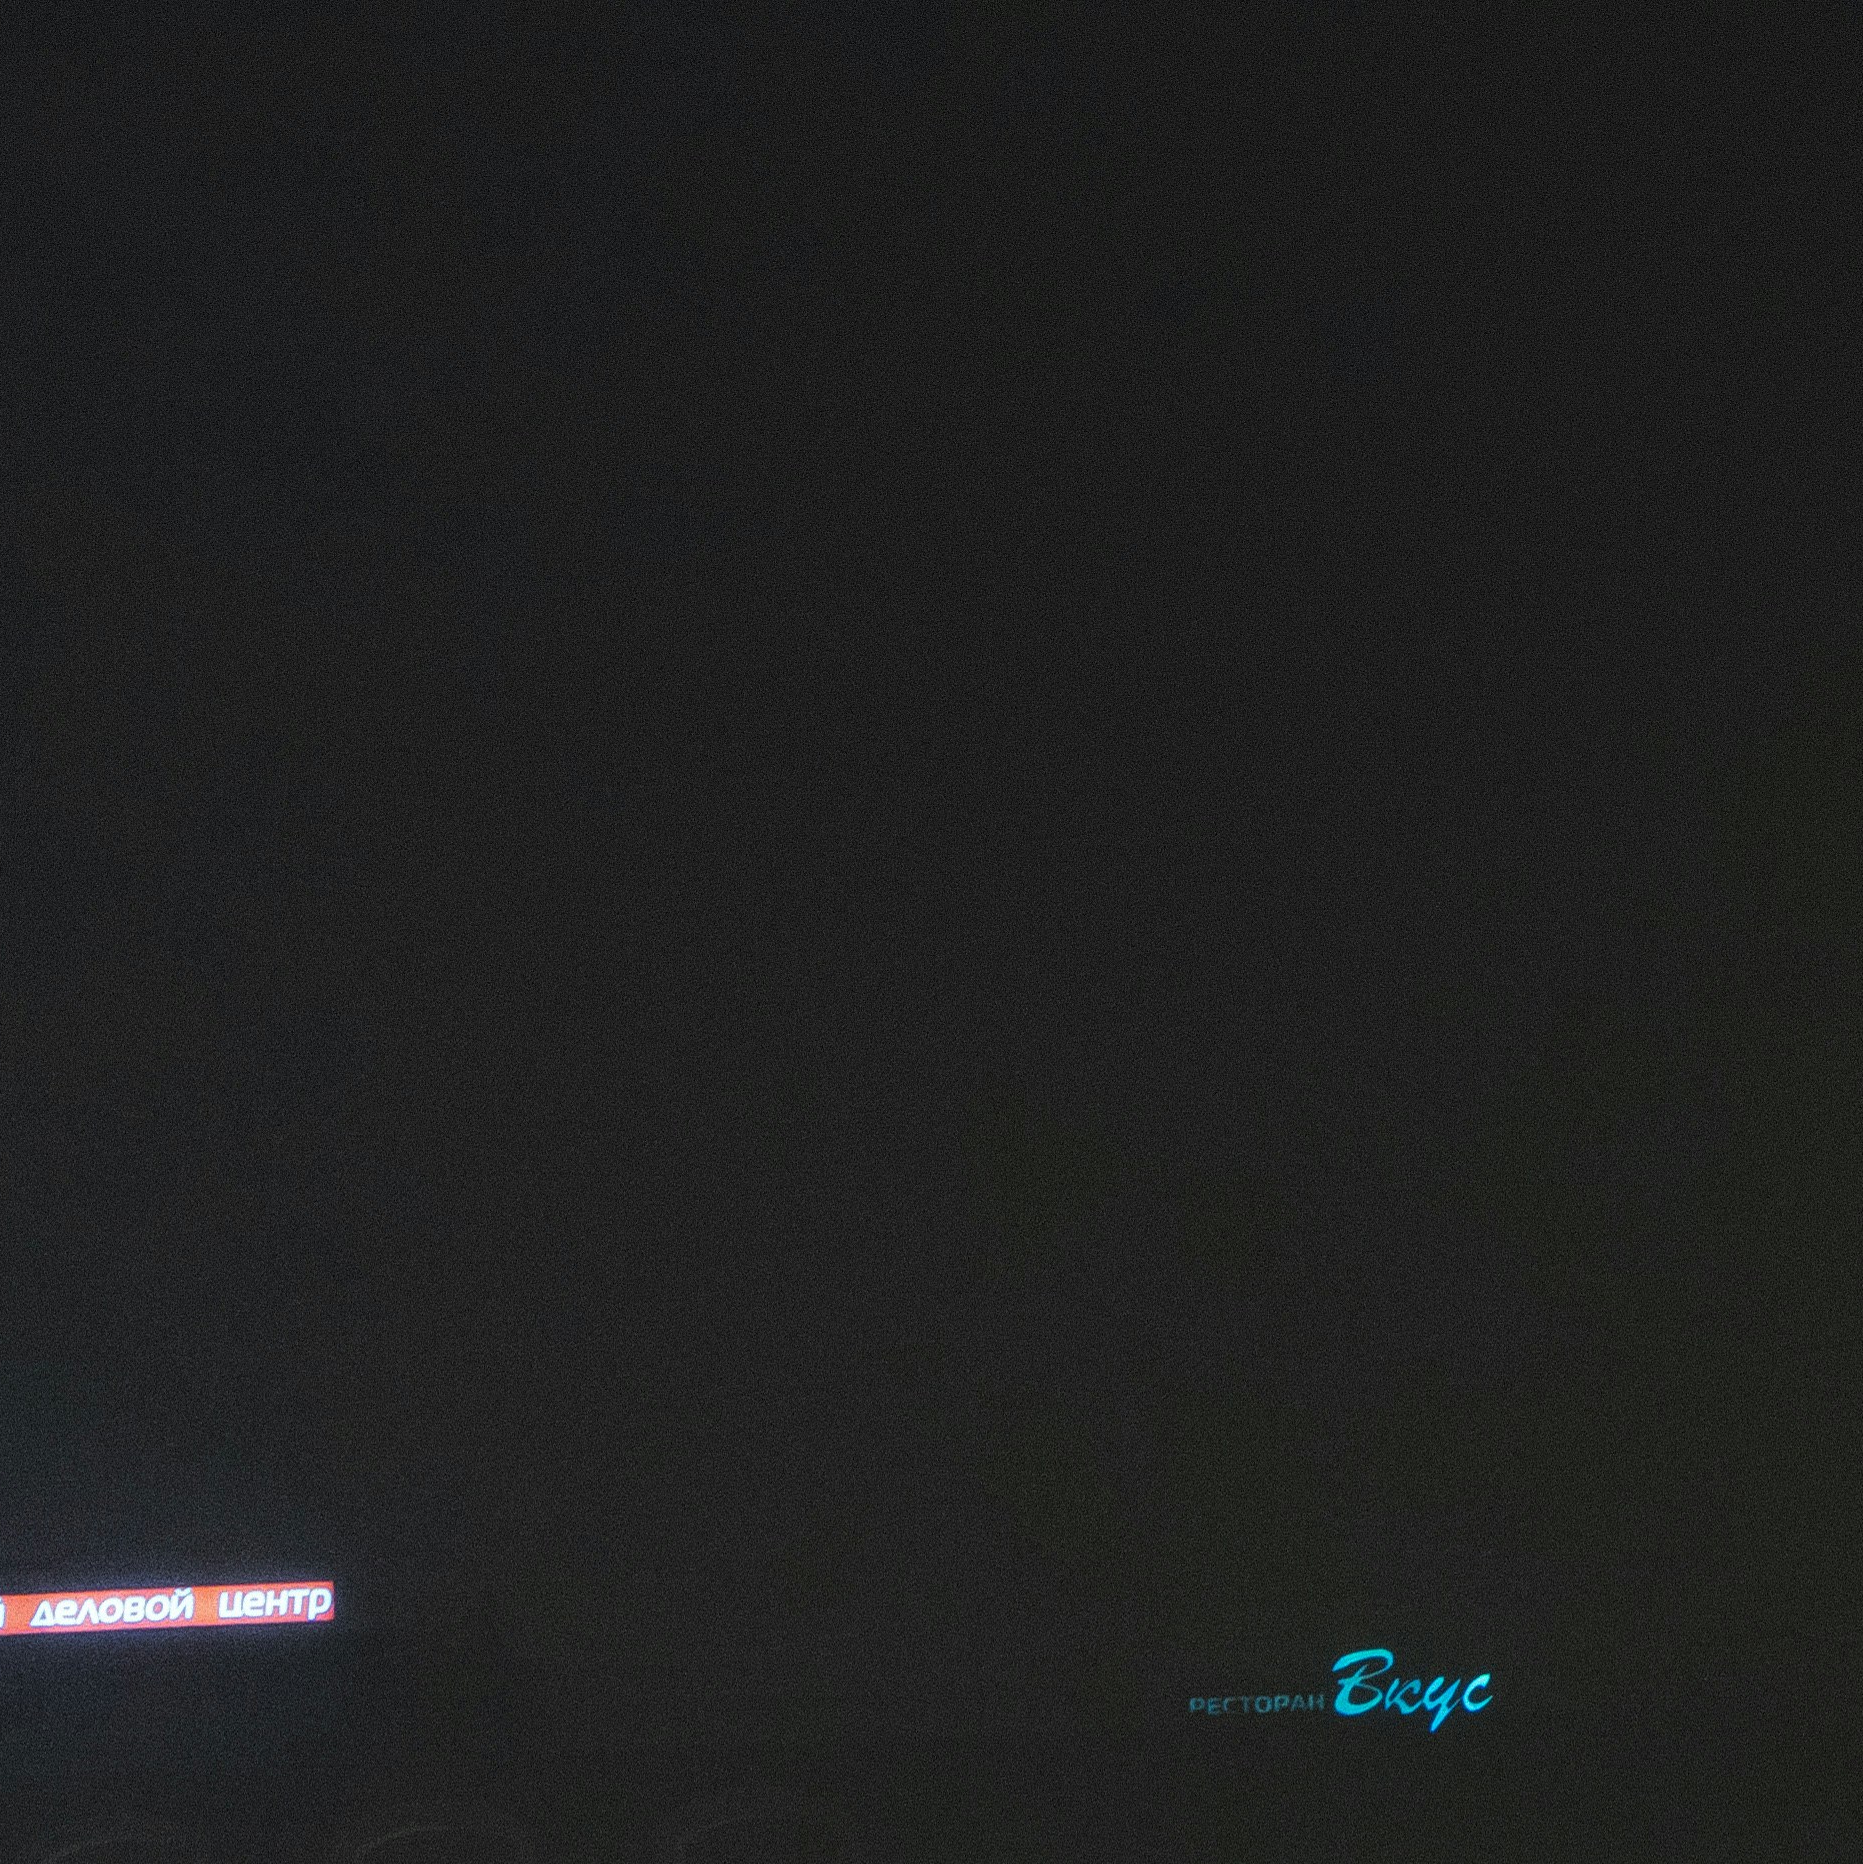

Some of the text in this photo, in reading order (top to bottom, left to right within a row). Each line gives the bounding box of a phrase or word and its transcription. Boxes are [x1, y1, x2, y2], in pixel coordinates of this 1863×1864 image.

[29, 1587, 193, 1627] деловой
[218, 1588, 332, 1621] центр
[1188, 1648, 1493, 1733] РЕСТОРАН Вкус
